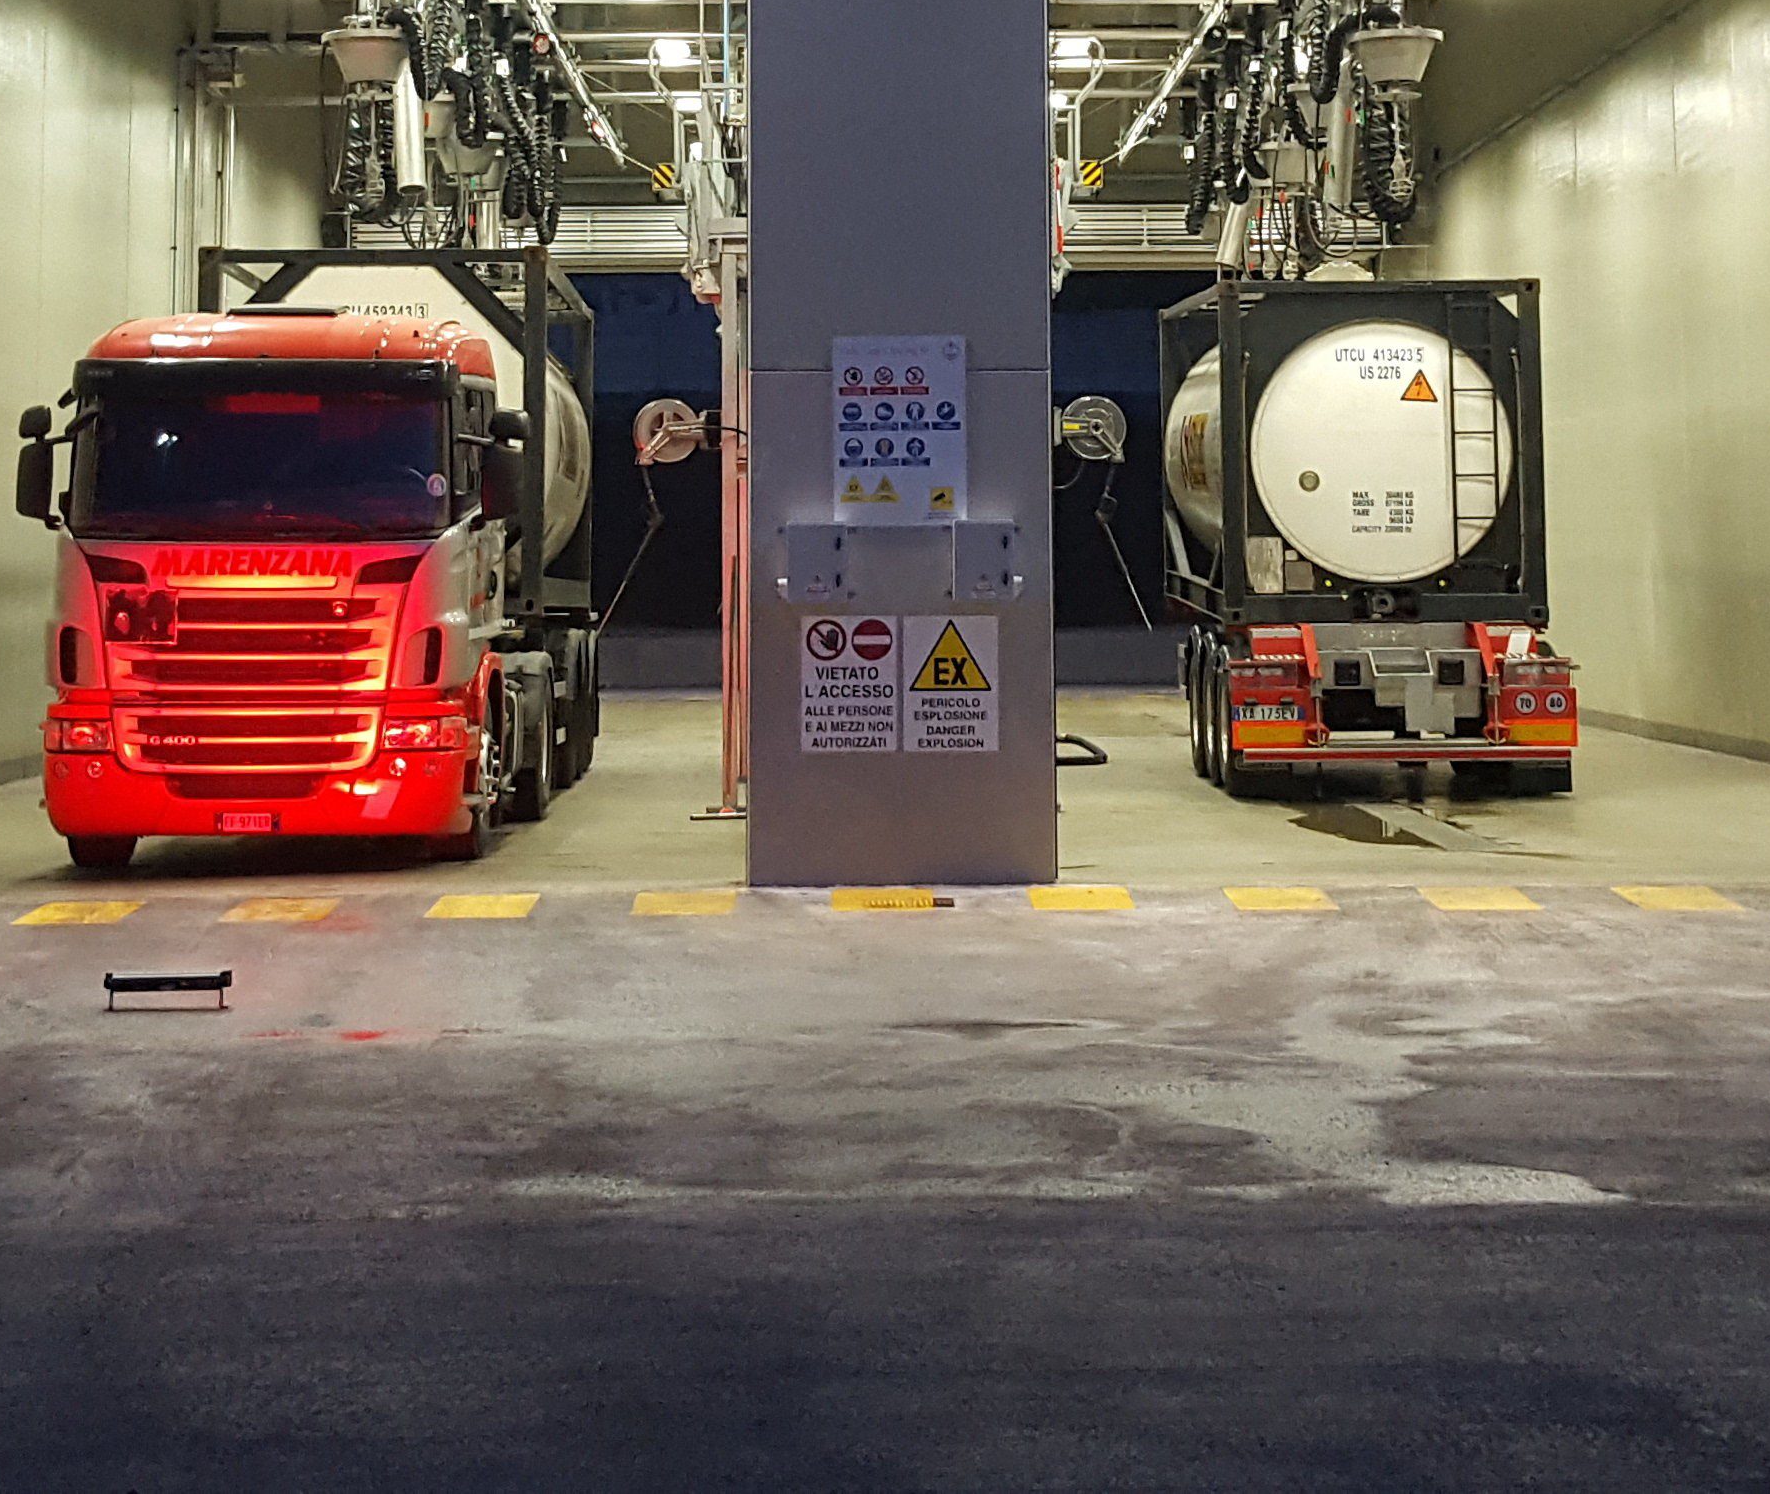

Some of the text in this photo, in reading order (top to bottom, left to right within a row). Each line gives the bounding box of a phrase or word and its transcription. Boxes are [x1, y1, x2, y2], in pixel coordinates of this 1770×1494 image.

[1335, 348, 1365, 362] UTCU
[1359, 365, 1402, 380] US 2276
[150, 548, 353, 577] MARENZANA
[815, 666, 879, 681] VIETATO
[933, 657, 968, 686] EX
[804, 685, 894, 698] L'ACCESSO
[921, 698, 981, 708] PERICOLO
[1519, 697, 1532, 710] 70
[804, 705, 894, 716] ALLE PERSONE
[914, 711, 988, 721] ESPLOSIONE
[830, 721, 866, 732] MEZZI
[868, 721, 894, 732] NON
[926, 725, 976, 736] DANGER
[162, 735, 196, 746] 400
[811, 737, 888, 748] AUTORIZZATI
[917, 738, 985, 749] EXPLOSION
